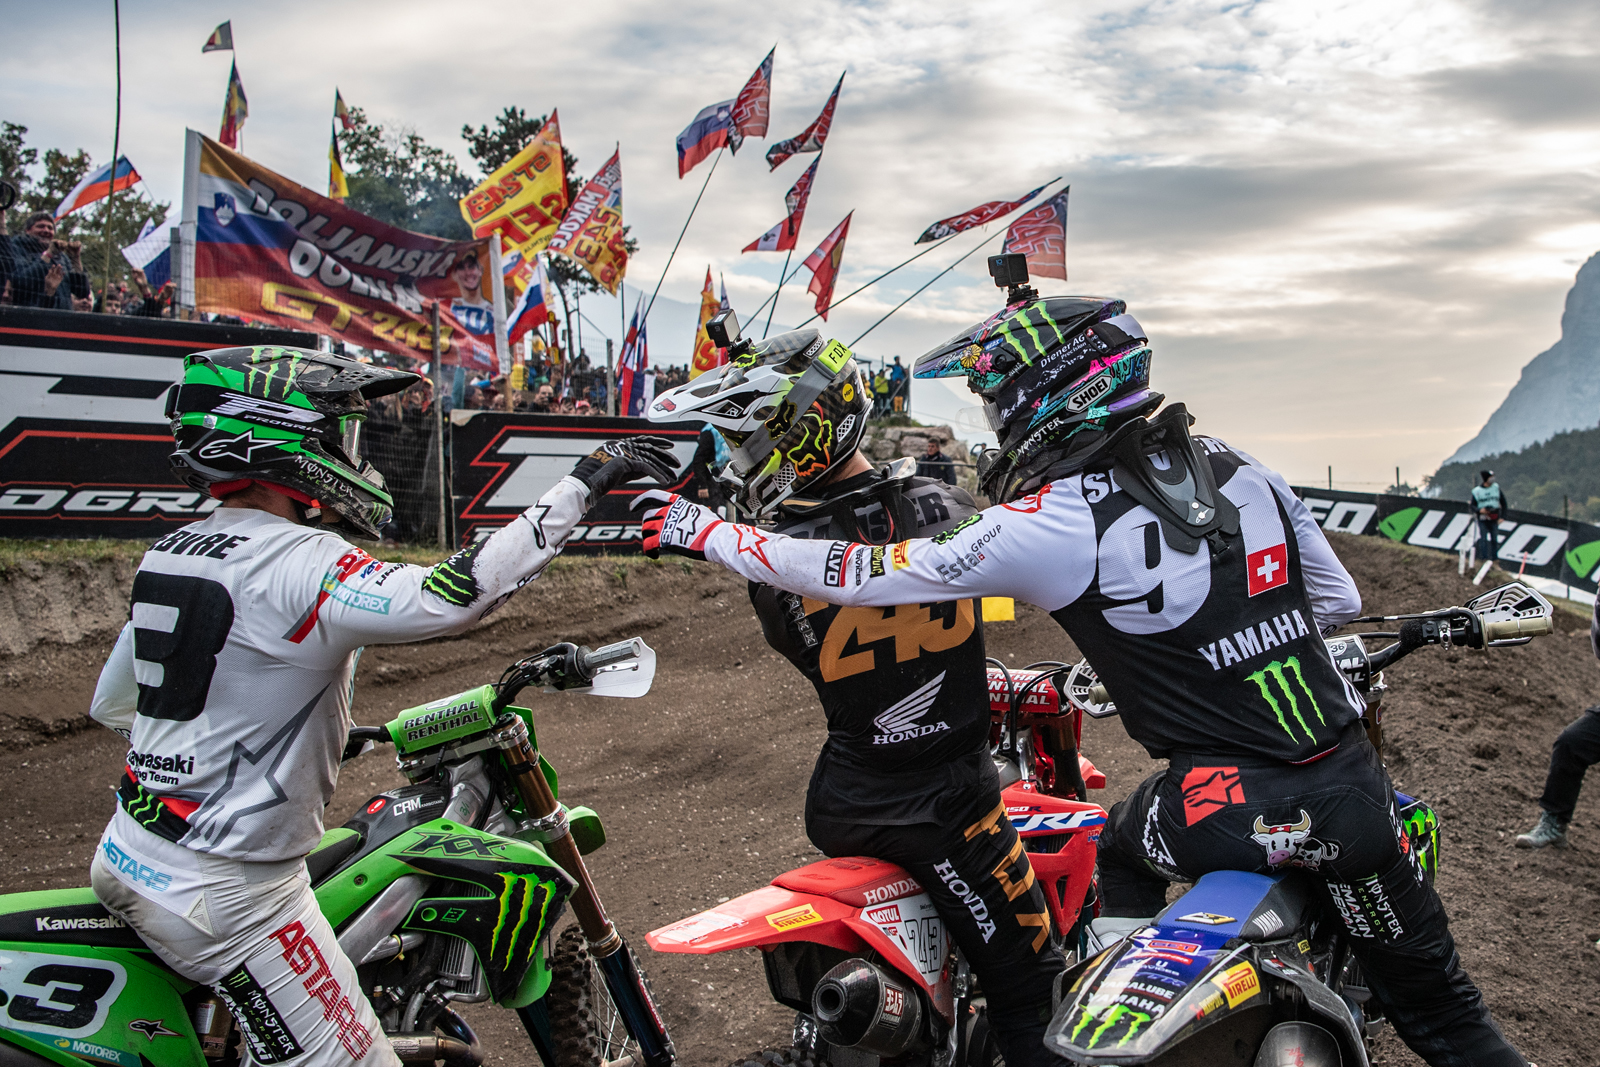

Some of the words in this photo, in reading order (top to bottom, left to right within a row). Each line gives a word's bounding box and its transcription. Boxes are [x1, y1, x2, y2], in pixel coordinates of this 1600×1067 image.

[828, 342, 847, 364] FOX
[1040, 342, 1072, 368] Diener
[1072, 334, 1086, 348] AG
[1060, 341, 1088, 361] Precision
[1072, 378, 1109, 410] SHOEI
[243, 414, 325, 435] PROGRIP
[970, 524, 1002, 553] GROUP
[935, 552, 981, 584] Esta
[131, 569, 236, 722] 3
[1197, 609, 1311, 672] YAMAHA
[403, 699, 480, 730] RENTHAL
[406, 711, 485, 743] RENTHAL
[872, 720, 951, 746] HONDA
[149, 770, 180, 786] Team
[393, 796, 422, 817] CRM
[1010, 808, 1104, 832] CRF
[863, 876, 920, 906] HONDA
[933, 858, 998, 945] HONDA
[36, 914, 126, 932] Kawasaki
[771, 909, 817, 928] PIRELLI
[869, 906, 901, 924] MOTUL
[1357, 887, 1385, 933] ENERGY
[903, 915, 942, 974] 243
[7, 963, 116, 1030] 3
[268, 920, 374, 1062] ASTARS
[1100, 980, 1176, 1000] YAMALUBE
[1221, 966, 1257, 1000] PIRELLI
[1087, 992, 1167, 1015] YAMAHA
[72, 1040, 122, 1063] MOTOREX
